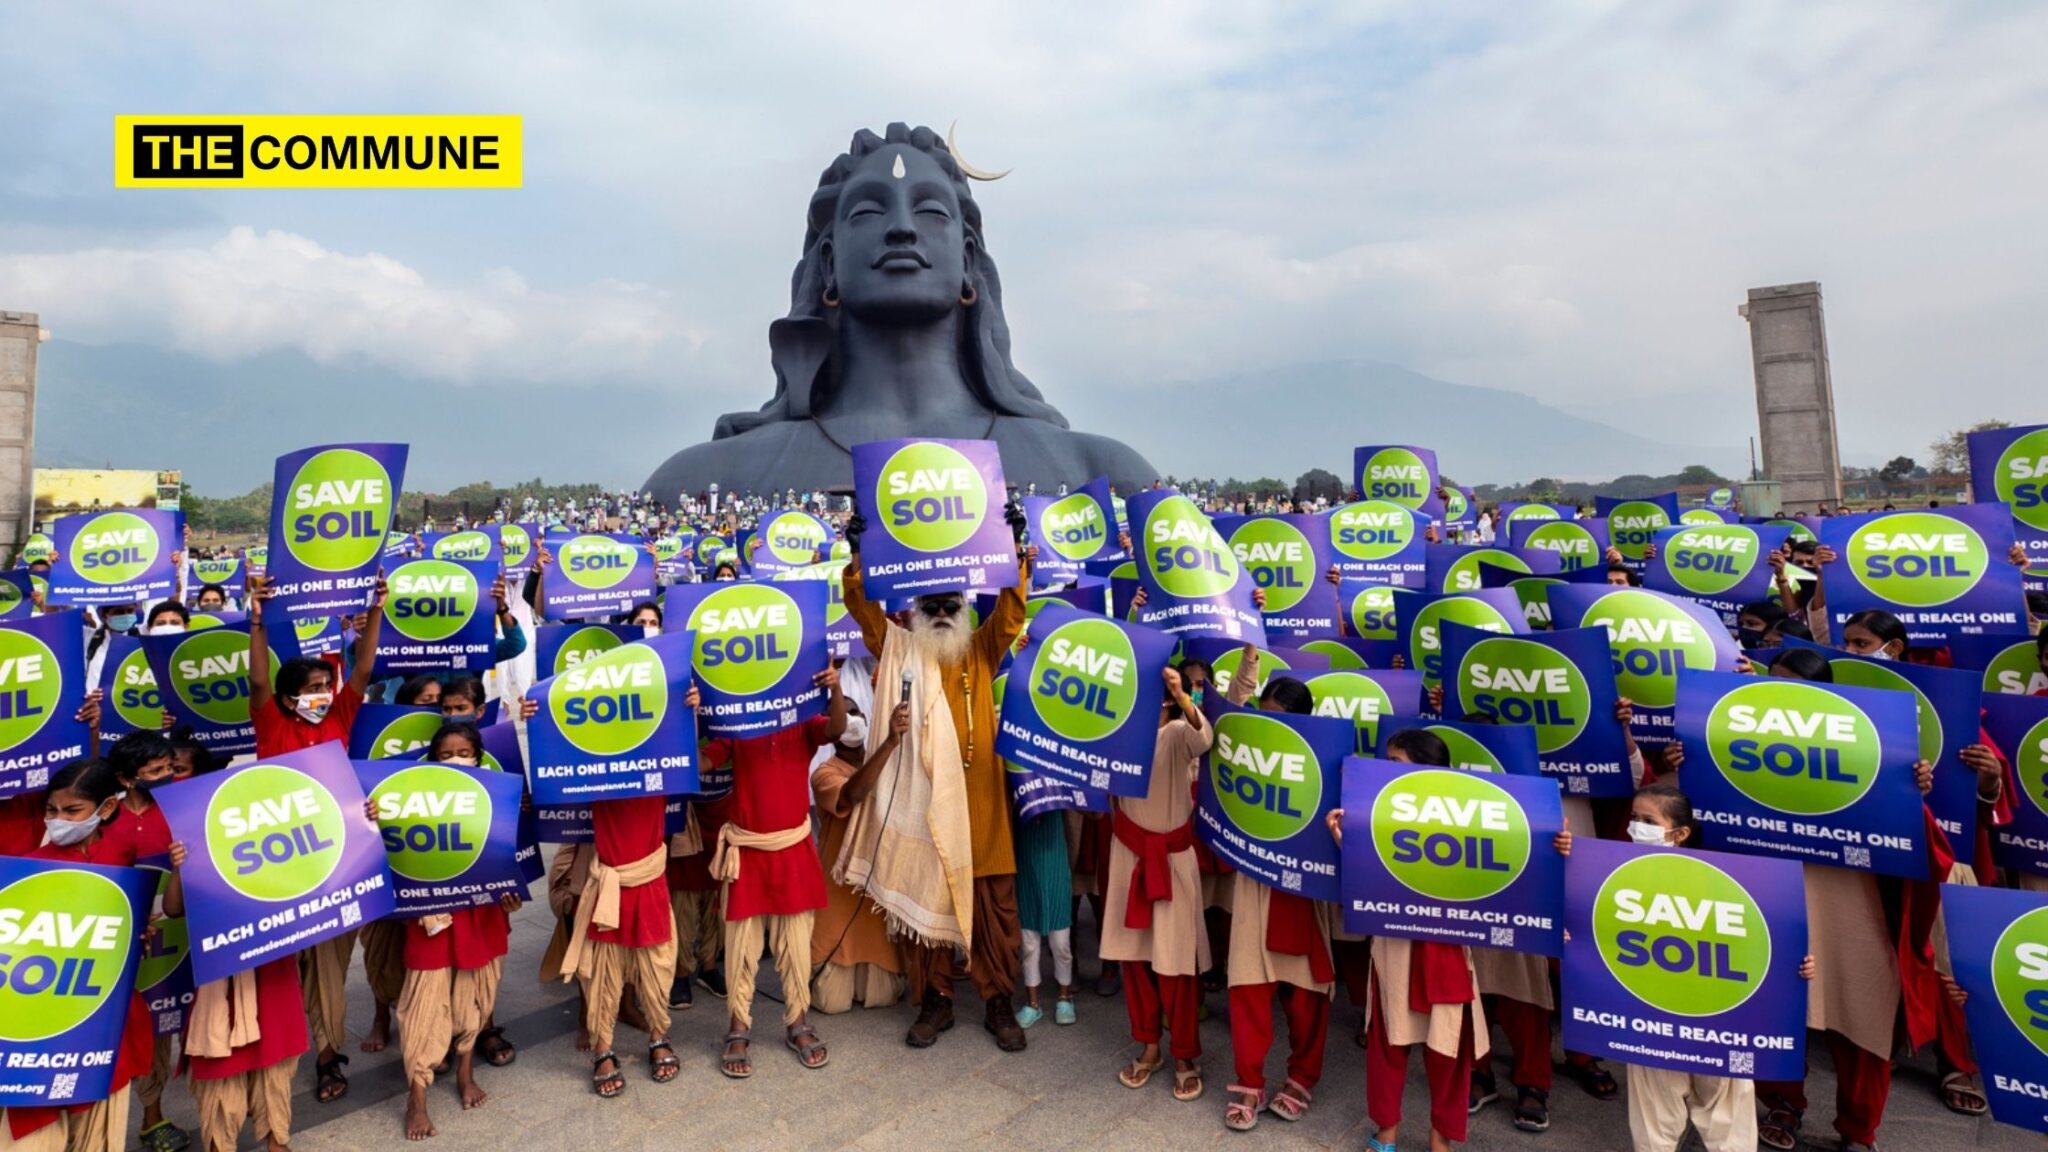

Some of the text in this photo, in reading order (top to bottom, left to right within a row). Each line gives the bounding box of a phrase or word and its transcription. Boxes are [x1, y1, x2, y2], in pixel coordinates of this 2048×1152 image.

[888, 467, 973, 496] SAVE
[1371, 465, 1422, 479] SAVE
[295, 479, 383, 510] SAVE
[1371, 482, 1422, 498] SOIL
[891, 495, 975, 527] SOIL
[1048, 504, 1097, 527] SAVE
[1340, 511, 1403, 527] SAVE
[1614, 513, 1663, 529] SAVE
[294, 511, 380, 543] SOIL
[775, 521, 820, 537] SAVE
[1051, 523, 1102, 544] SOIL
[1152, 519, 1229, 553] SAVE
[1338, 529, 1402, 544] SOIL
[82, 529, 147, 550] SAVE
[441, 537, 485, 551] SAVE
[773, 535, 817, 551] SOIL
[1533, 538, 1589, 553] SAVE
[1679, 533, 1751, 553] SAVE
[1864, 532, 1969, 553] SAVE
[83, 547, 147, 568] SOIL
[442, 549, 484, 559] SOIL
[570, 554, 628, 572] SOIL
[1155, 545, 1230, 577] SOIL
[1233, 542, 1303, 562] SAVE
[1673, 550, 1739, 575] SOIL
[199, 562, 231, 573] SOIL
[869, 553, 1010, 577] EACH ONE REACH ONE
[1252, 566, 1303, 588] OIL
[1343, 563, 1365, 571] ONE
[1366, 563, 1401, 571] REACH
[1403, 563, 1425, 572] ONE
[1866, 554, 1971, 579] SOIL
[54, 586, 84, 594] EACH
[115, 584, 147, 593] REACH
[302, 579, 332, 592] ONE
[395, 575, 467, 594] SAVE
[599, 591, 629, 600] REACH
[631, 589, 650, 597] ONE
[892, 575, 967, 590] consciousplanet.org
[394, 597, 464, 618] SOIL
[699, 603, 789, 634] SAVE
[1143, 604, 1258, 627] EACH ONE REACH ONE
[1919, 613, 2016, 623] REACH ONE
[1266, 619, 1331, 627] REACH ONE
[1593, 618, 1696, 644] SAVE
[401, 642, 489, 656] ONE REACH ONE
[701, 633, 789, 667] SOIL
[179, 650, 250, 681] SAV
[1048, 638, 1128, 686] SAVE
[124, 665, 158, 686] SA
[564, 661, 653, 692] SAVE
[1470, 663, 1570, 693] SAVE
[121, 688, 165, 708] SO
[188, 676, 250, 704] SOI
[1037, 668, 1116, 720] SOIL
[564, 693, 654, 725] SOIL
[716, 688, 821, 717] ONE REACH ONE
[1312, 696, 1380, 721] AVE
[1473, 693, 1575, 725] SOIL
[213, 729, 238, 739] ONE
[708, 719, 778, 732] consciousplanet.org
[1727, 704, 1857, 743] SAVE
[0, 745, 82, 771] EACH ONE
[1003, 720, 1142, 775] EACH ONE REACH ONE
[1217, 731, 1306, 782] SAVE
[537, 756, 690, 779] EACH ONE REACH ONE
[1016, 749, 1088, 781] consciousplanet.org
[1539, 761, 1621, 774] EACH ONE
[1728, 739, 1858, 784] SOIL
[561, 781, 642, 794] consciousplanet.org
[1018, 778, 1043, 795] ONE
[1217, 762, 1302, 819] SOIL
[219, 787, 321, 838] SAVE
[378, 791, 478, 821] SAVE
[539, 810, 575, 820] EACH
[665, 803, 681, 814] NE
[1390, 793, 1509, 831] SAVE
[383, 822, 473, 853] SOIL
[1199, 806, 1336, 875] EACH ONE REACH ONE
[1692, 808, 1912, 851] EACH ONE REACH ONE
[231, 823, 334, 875] SOIL
[1392, 829, 1510, 872] SOIL
[1726, 834, 1838, 860] consciousplanet.org
[400, 879, 517, 899] ONE REACH ONE
[202, 874, 384, 952] EACH ONE REACH ONE
[1353, 900, 1554, 930] EACH ONE REACH ONE
[1613, 888, 1747, 938] SAVE
[240, 919, 339, 961] consciousplanet.org
[1384, 922, 1485, 940] consciousplanet.org
[1616, 929, 1748, 983] SOIL
[0, 953, 102, 997] OIL
[1573, 1007, 1794, 1050] EACH ONE REACH ONE
[7, 1050, 113, 1068] REACH ONE
[1608, 1040, 1723, 1068] consciousplanet.org
